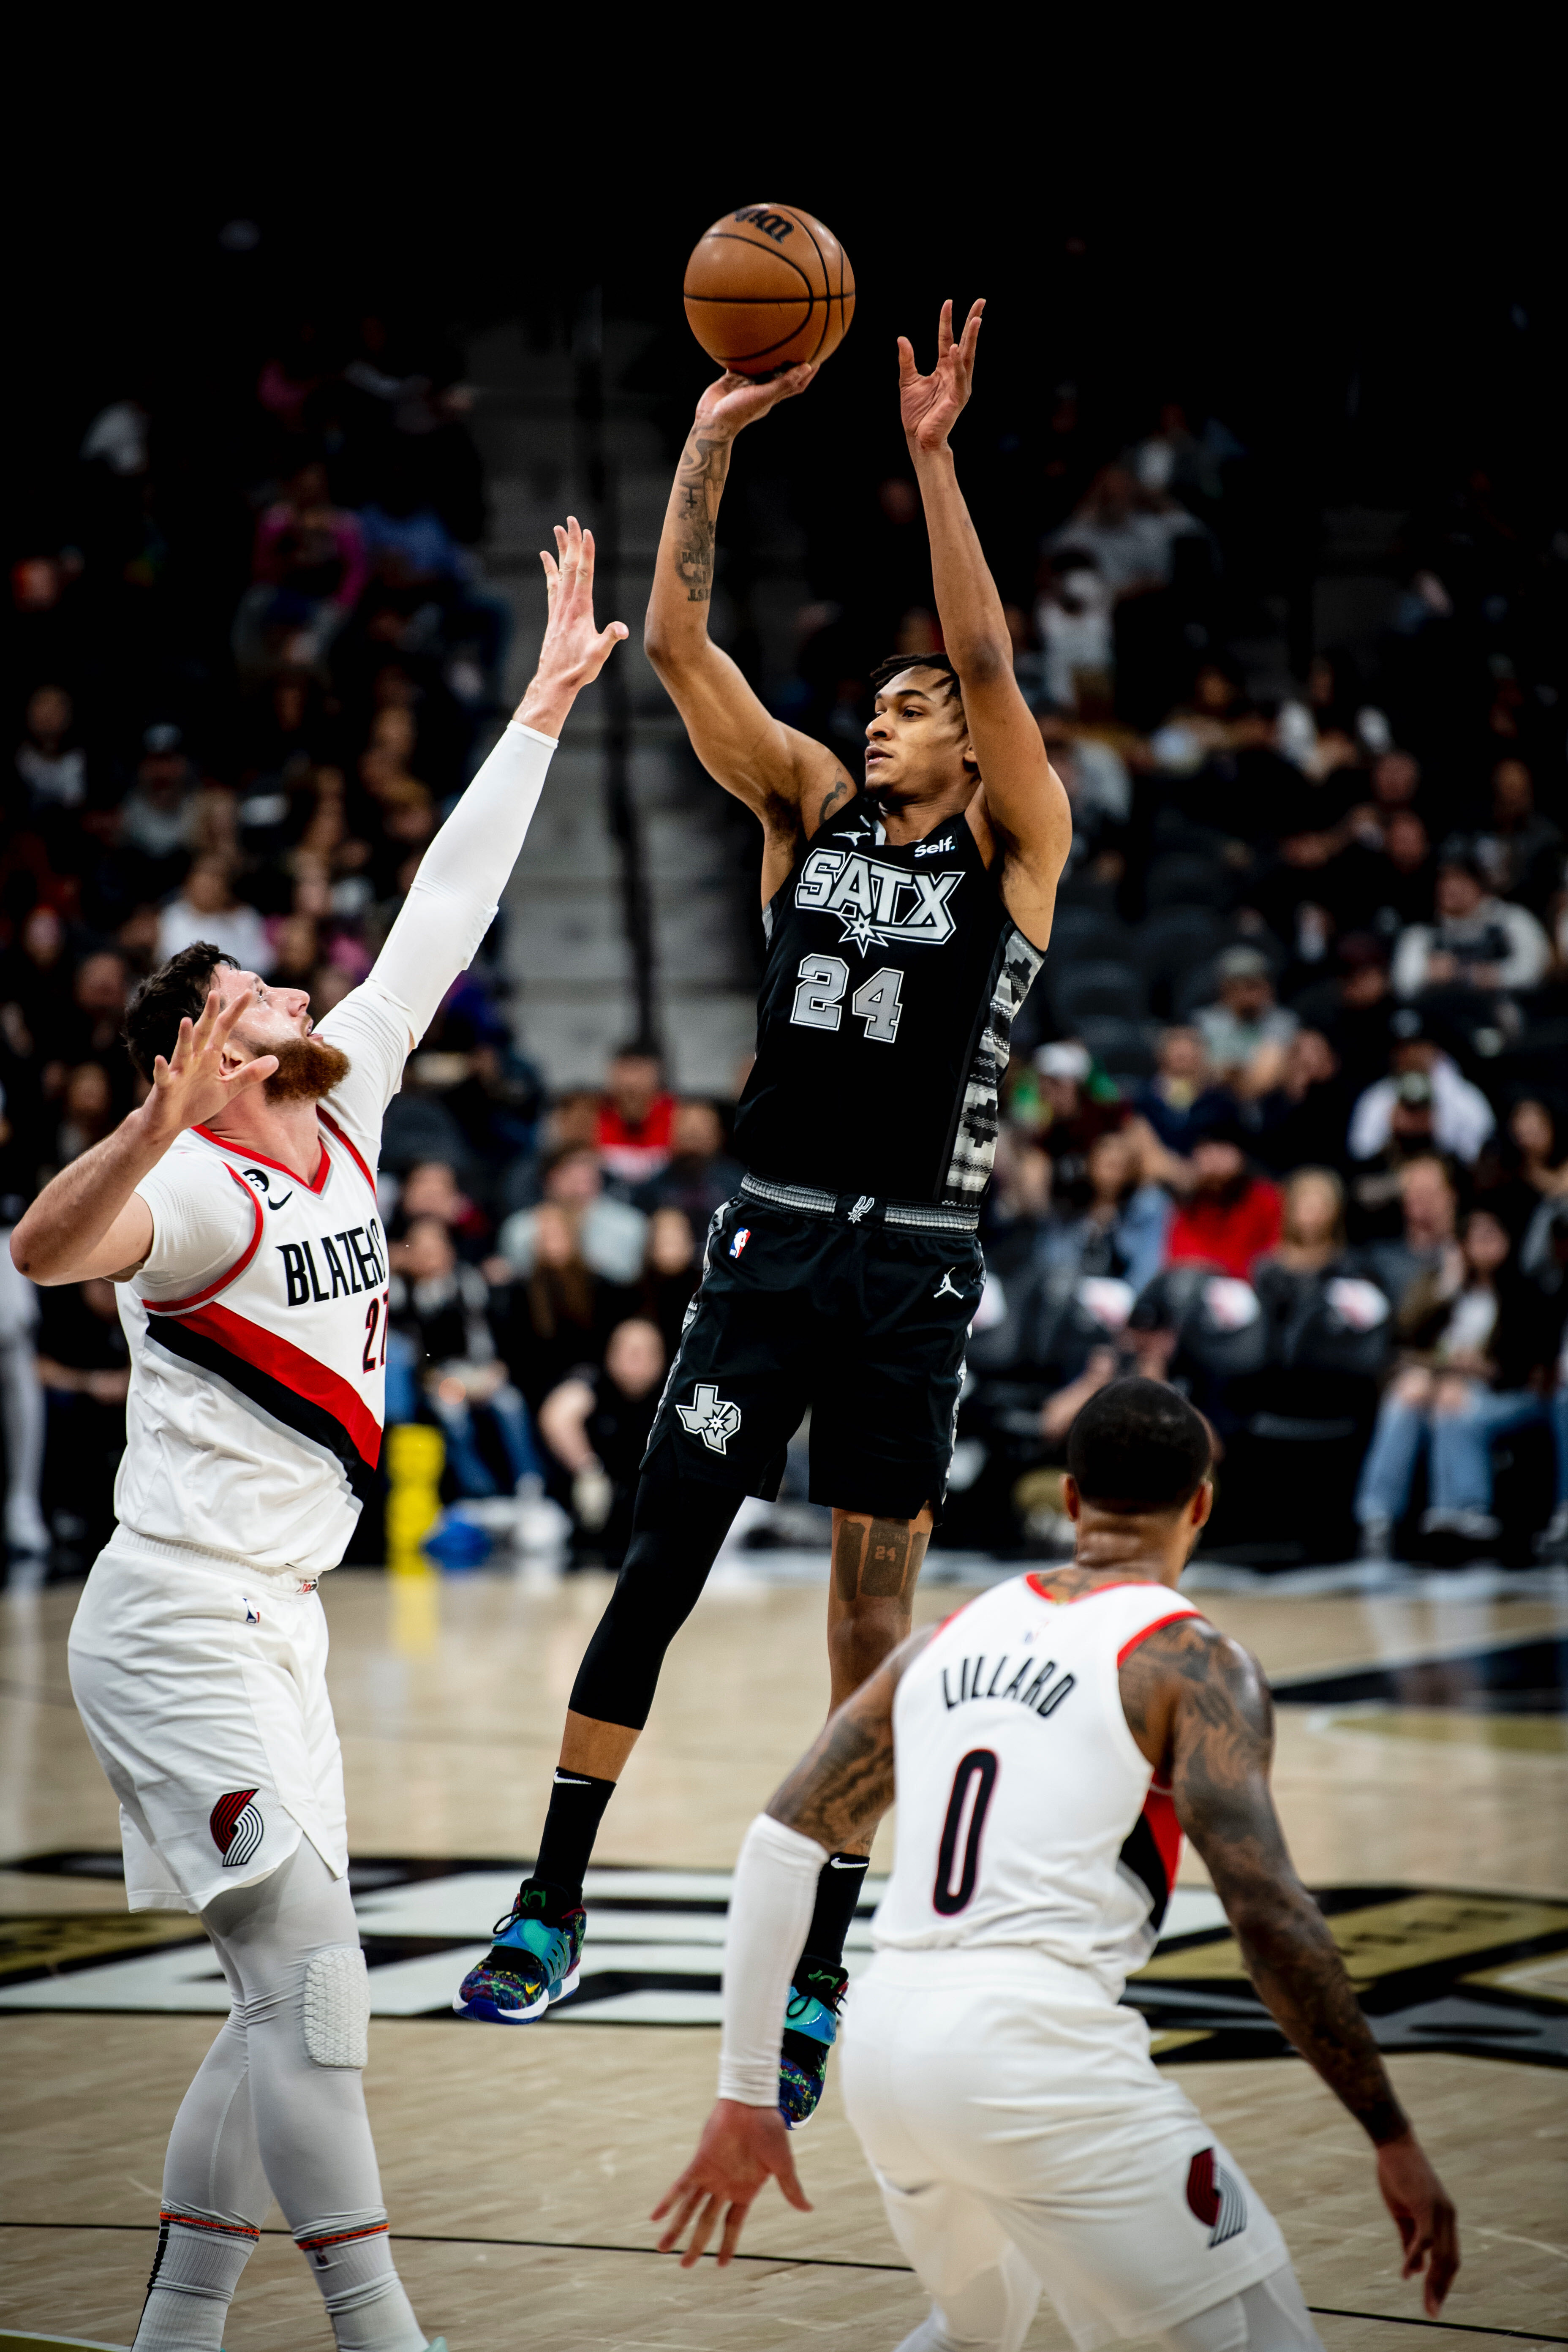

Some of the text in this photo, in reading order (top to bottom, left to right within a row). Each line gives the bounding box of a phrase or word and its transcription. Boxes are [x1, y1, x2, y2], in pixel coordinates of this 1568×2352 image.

[795, 848, 966, 945] SATX
[789, 953, 904, 1043] 24
[875, 1546, 896, 1561] 24
[942, 1655, 1075, 1718] LILLARD
[933, 1748, 1001, 1918] 0
